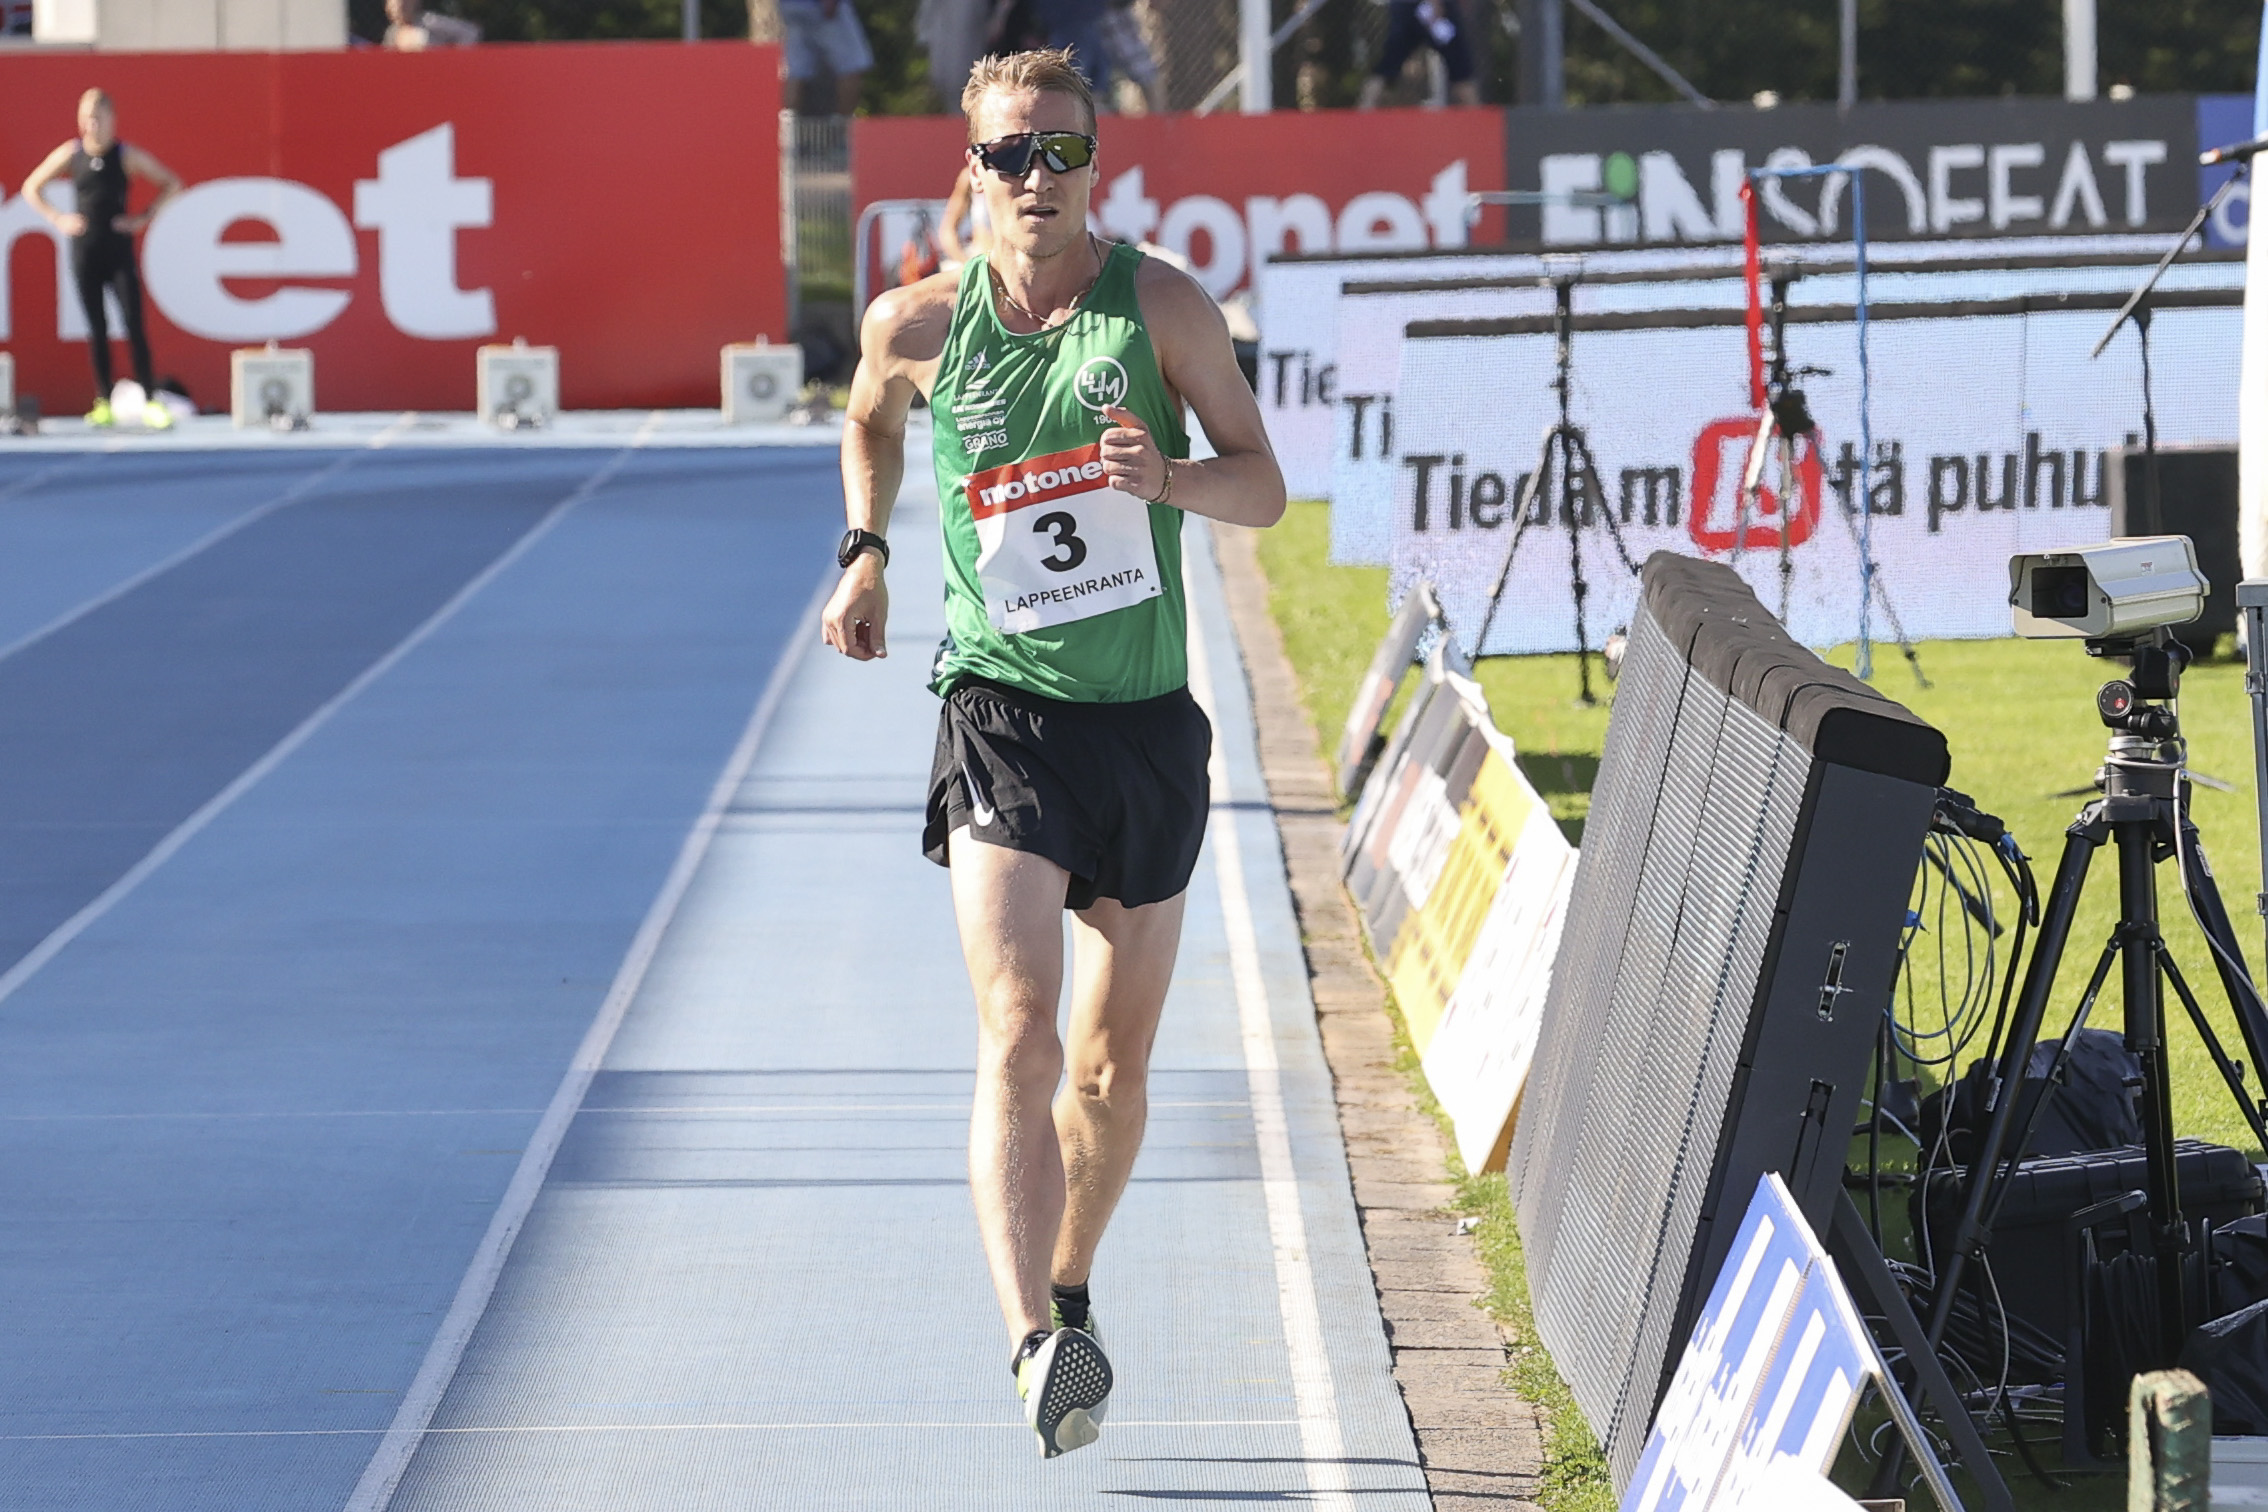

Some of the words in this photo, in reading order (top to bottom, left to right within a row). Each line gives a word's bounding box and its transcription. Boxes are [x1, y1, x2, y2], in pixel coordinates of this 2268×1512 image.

[964, 432, 1008, 450] GRANO
[1093, 413, 1119, 425] 190
[979, 461, 1103, 507] motone
[1032, 511, 1088, 573] 3
[1004, 568, 1144, 613] LAPPEENRANTA
